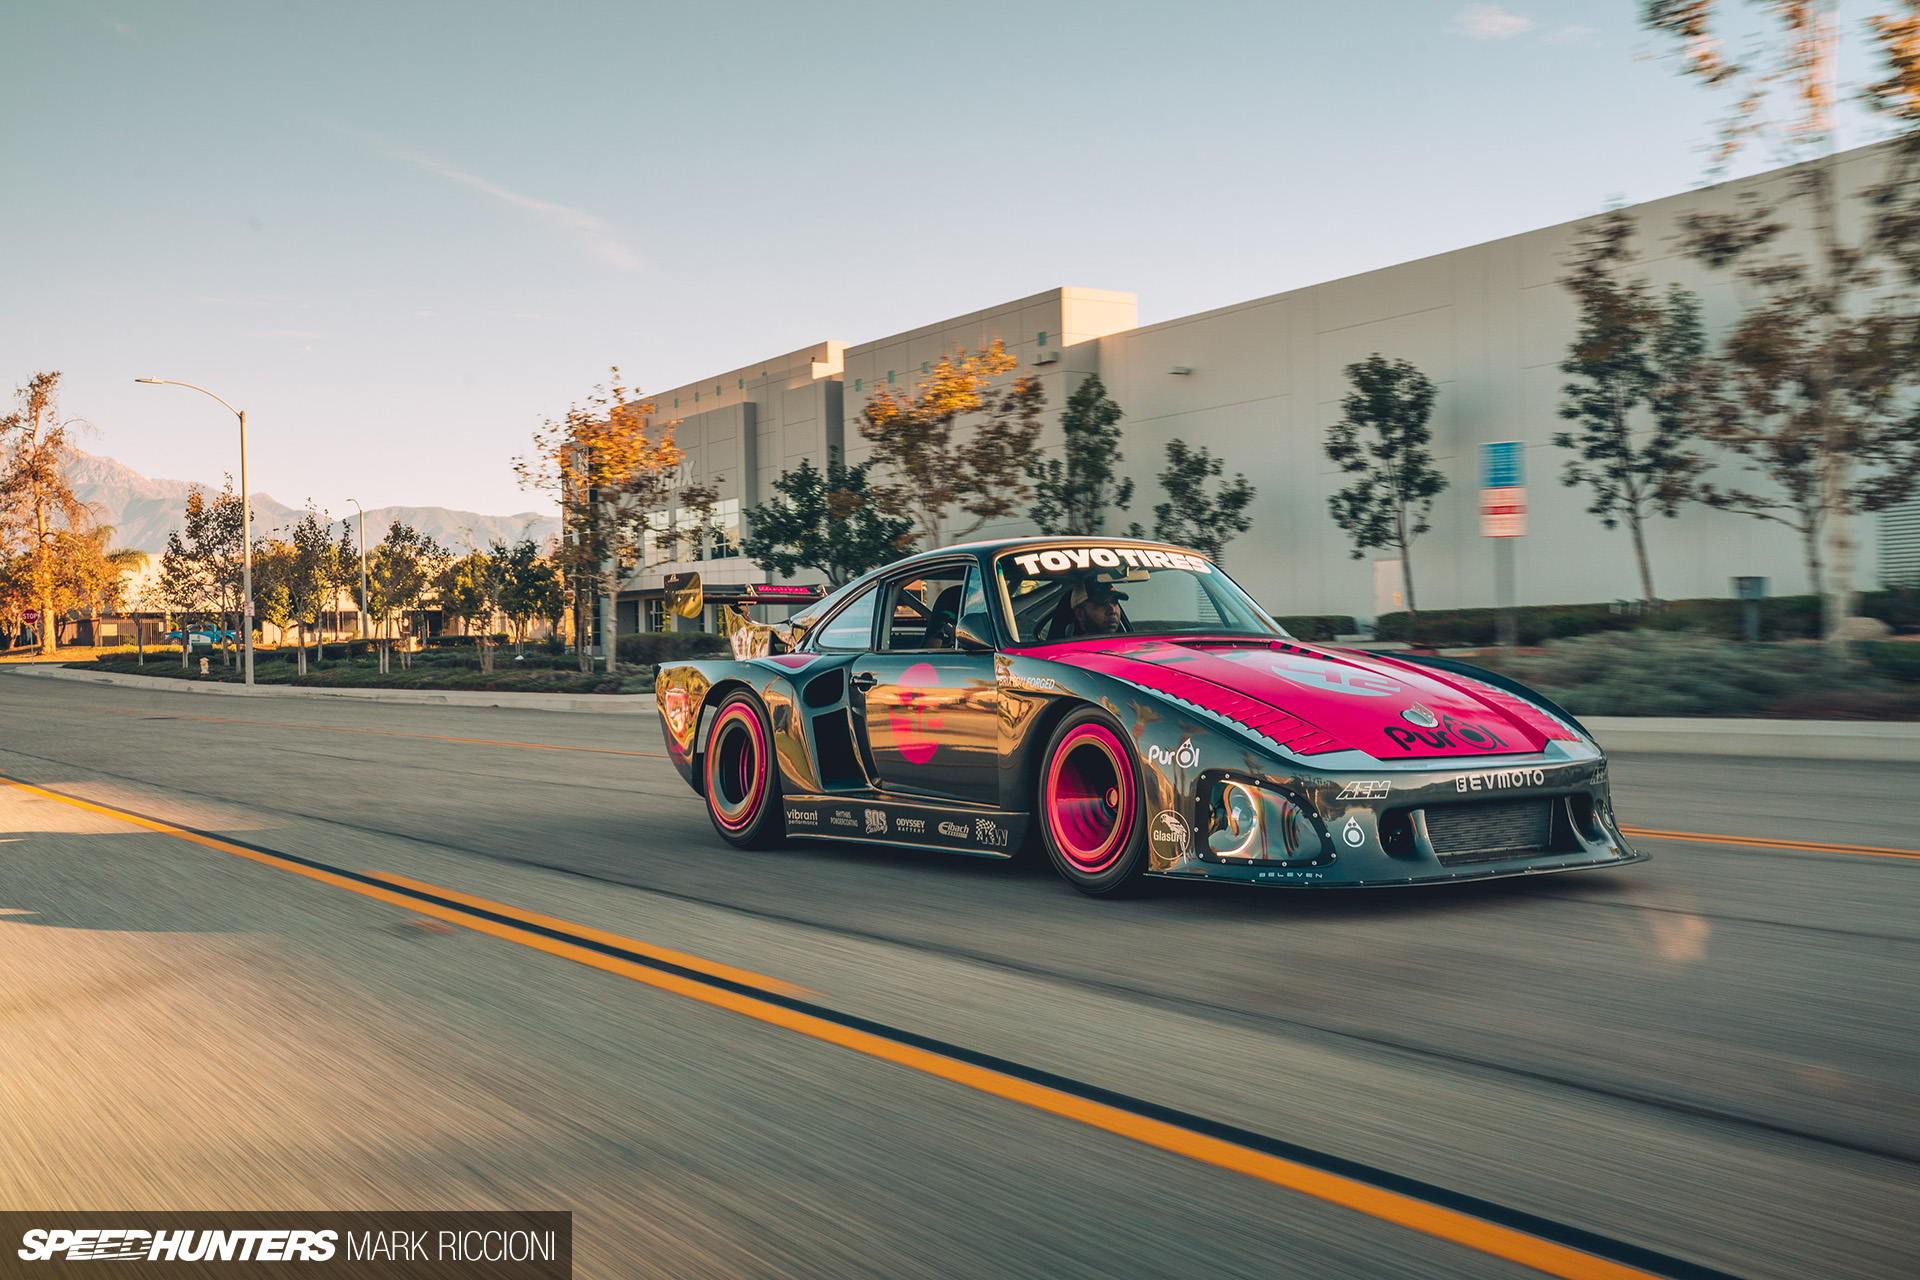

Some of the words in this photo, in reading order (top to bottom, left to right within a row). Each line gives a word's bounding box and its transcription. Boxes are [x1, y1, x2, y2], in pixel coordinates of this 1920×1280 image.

[1026, 677, 1055, 690] FORGED
[1335, 780, 1391, 800] AEM
[786, 809, 818, 821] vibrant
[896, 818, 925, 829] ODYSSEY
[938, 821, 970, 835] Eibach
[1153, 829, 1187, 843] Glasurit
